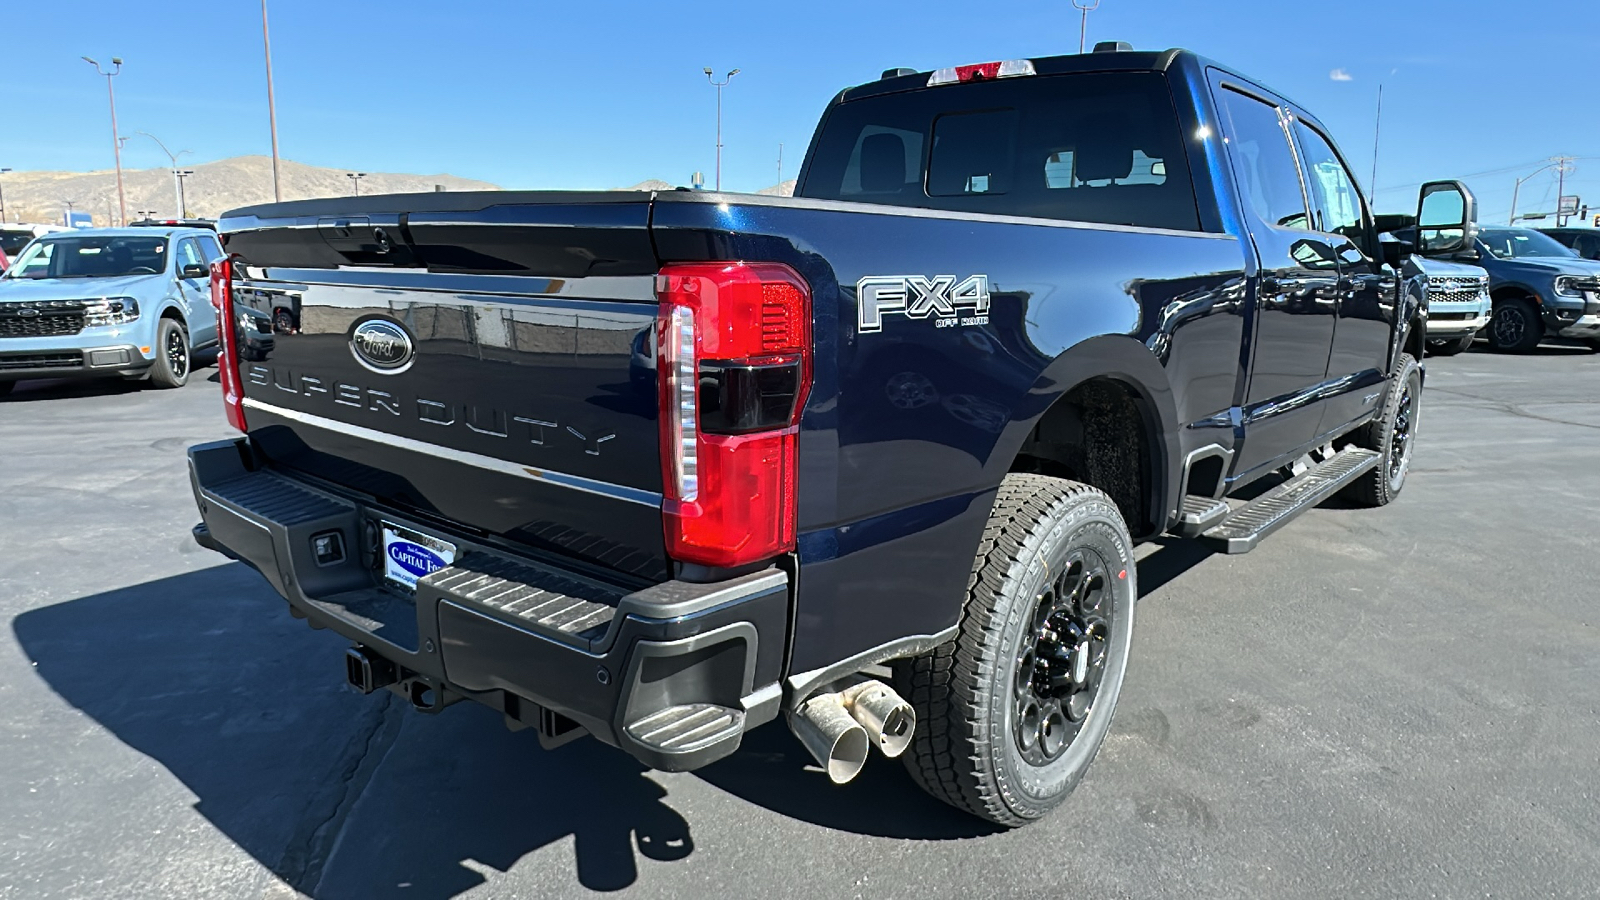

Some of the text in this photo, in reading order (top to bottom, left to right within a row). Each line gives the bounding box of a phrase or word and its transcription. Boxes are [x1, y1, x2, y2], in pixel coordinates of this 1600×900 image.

[857, 274, 990, 334] FX4
[935, 316, 989, 329] OFF ROAD
[361, 329, 394, 357] Ford
[249, 365, 616, 456] SUPER DUTY
[391, 546, 426, 571] CAPITAL
